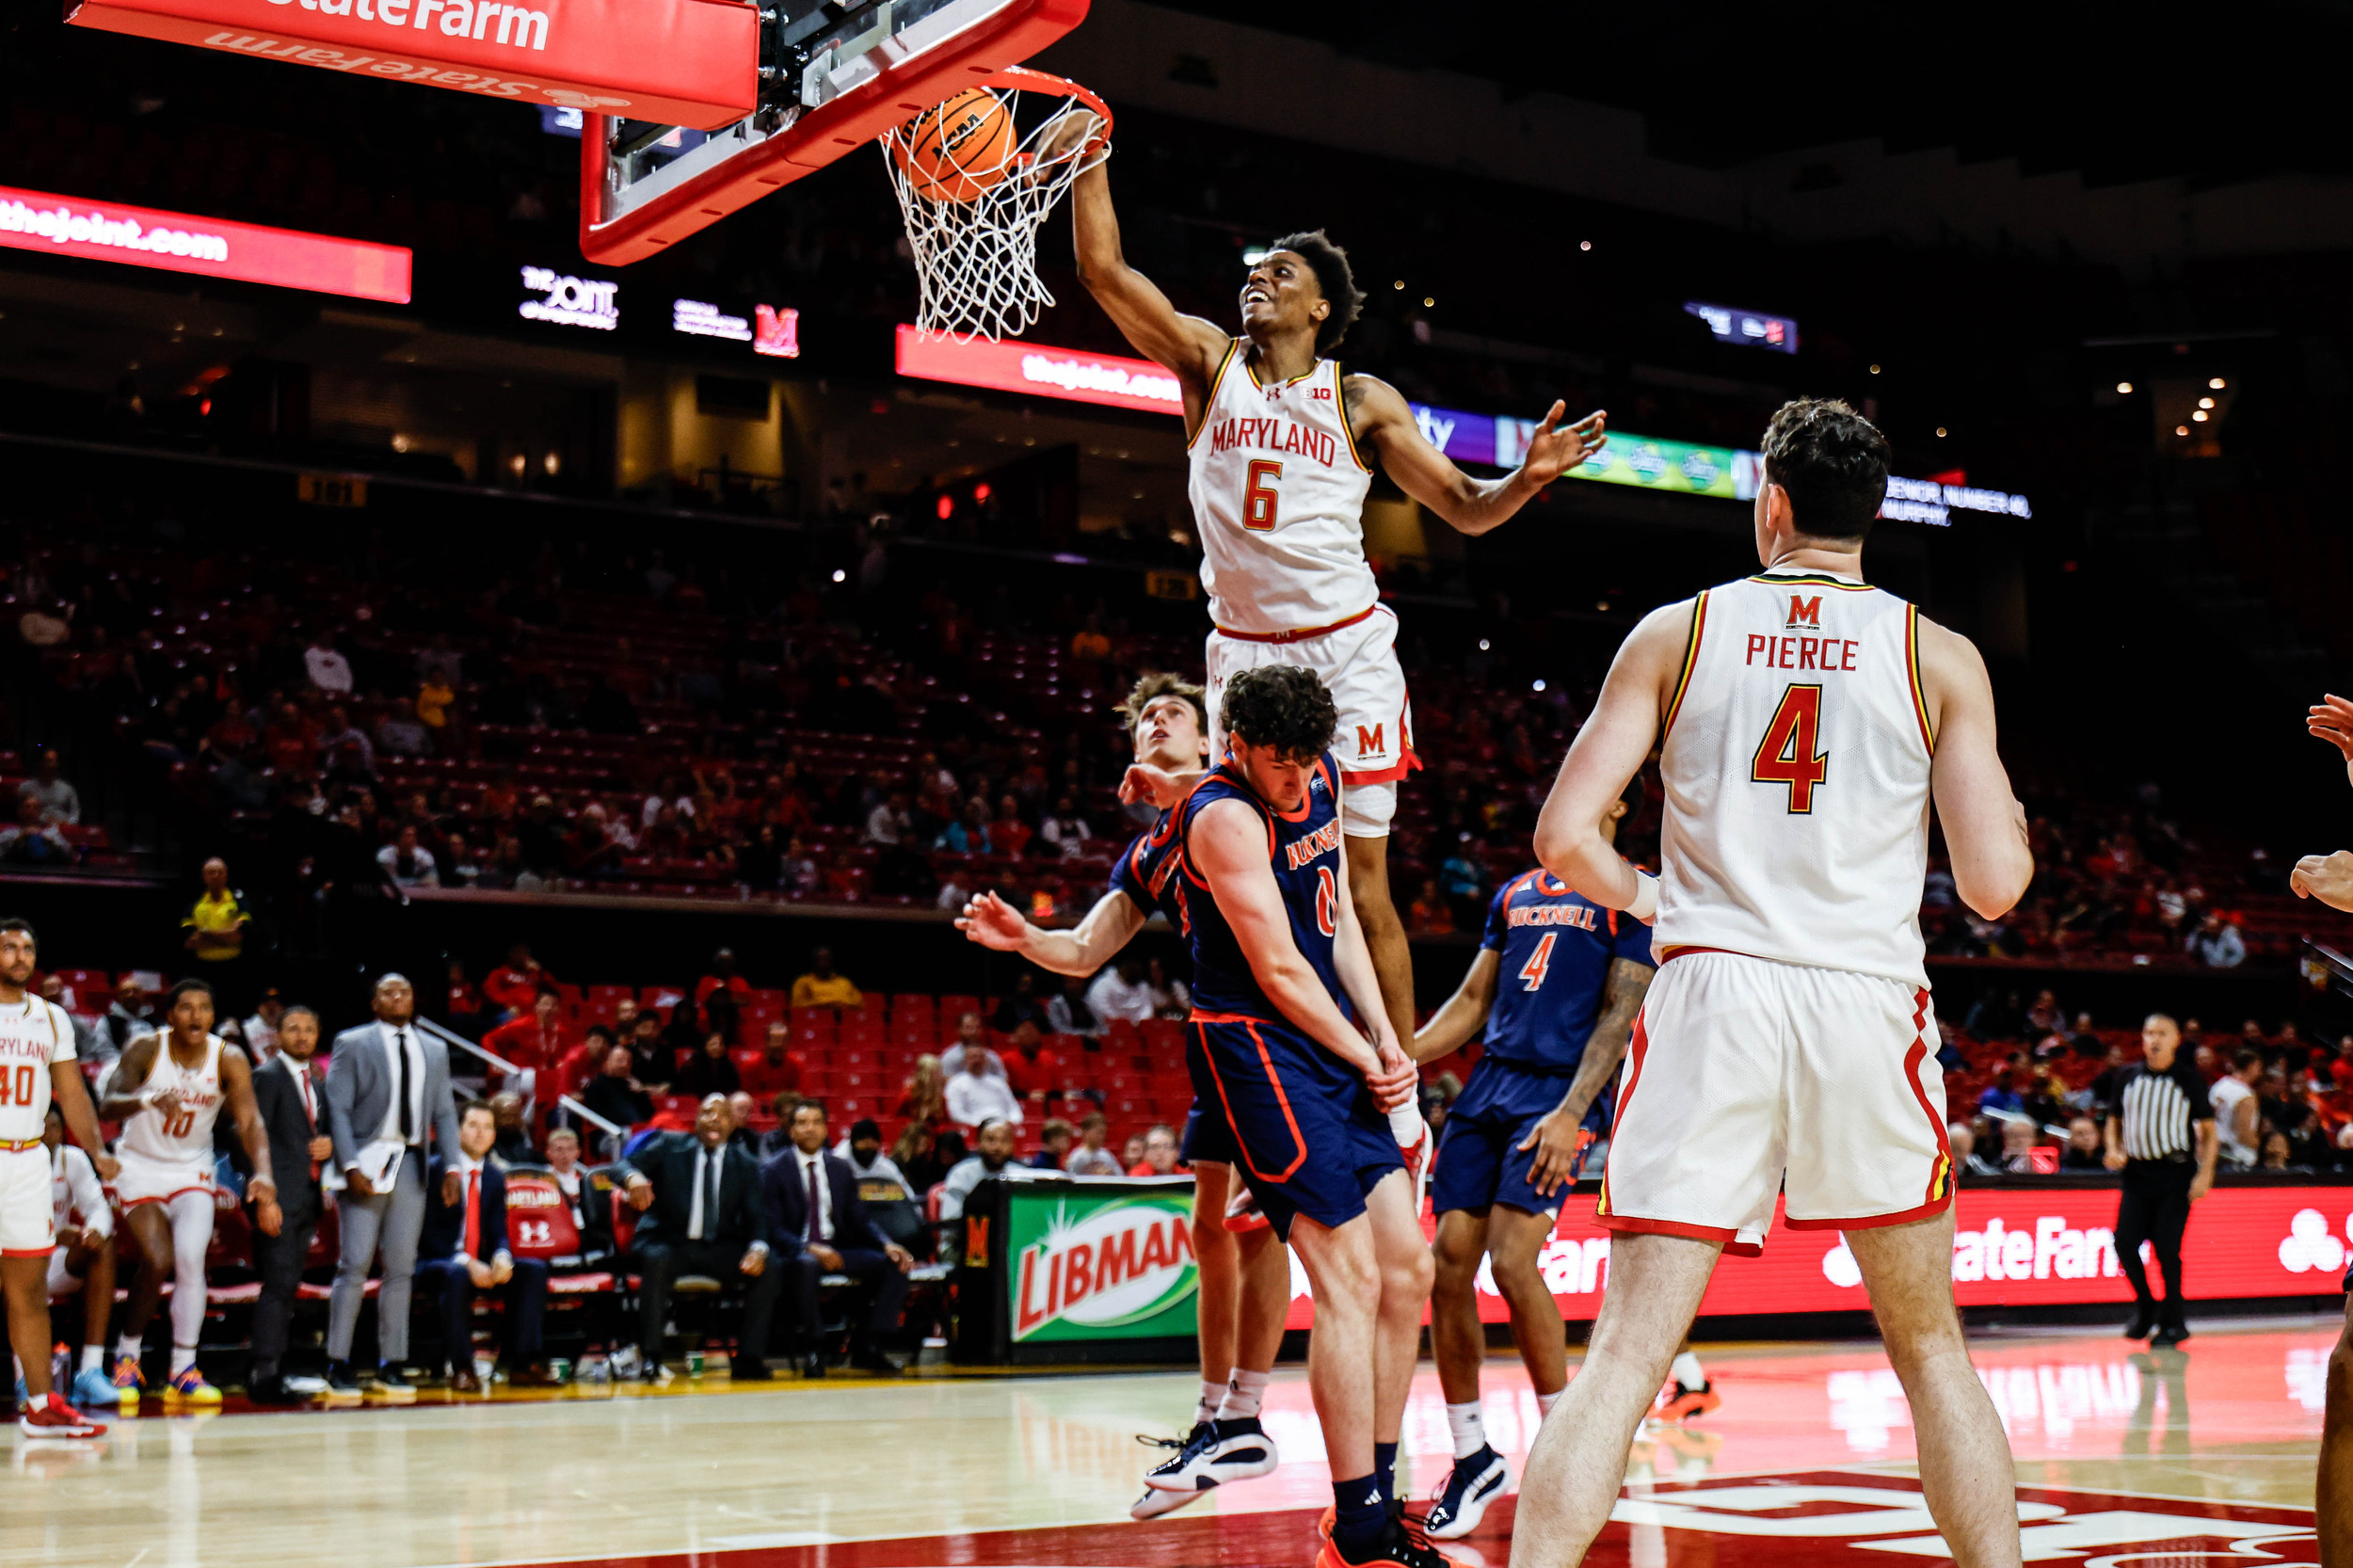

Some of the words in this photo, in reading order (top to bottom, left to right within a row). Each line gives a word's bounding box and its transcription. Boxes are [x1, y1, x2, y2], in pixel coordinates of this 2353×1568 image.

[203, 31, 539, 97] StateFarm
[1210, 417, 1336, 469] MARYLAND
[1242, 458, 1284, 532] 6
[1785, 595, 1823, 625] M
[1746, 633, 1859, 671] PIERCE
[1355, 723, 1385, 756] M
[1750, 683, 1830, 815] 4
[1518, 931, 1559, 992] 4
